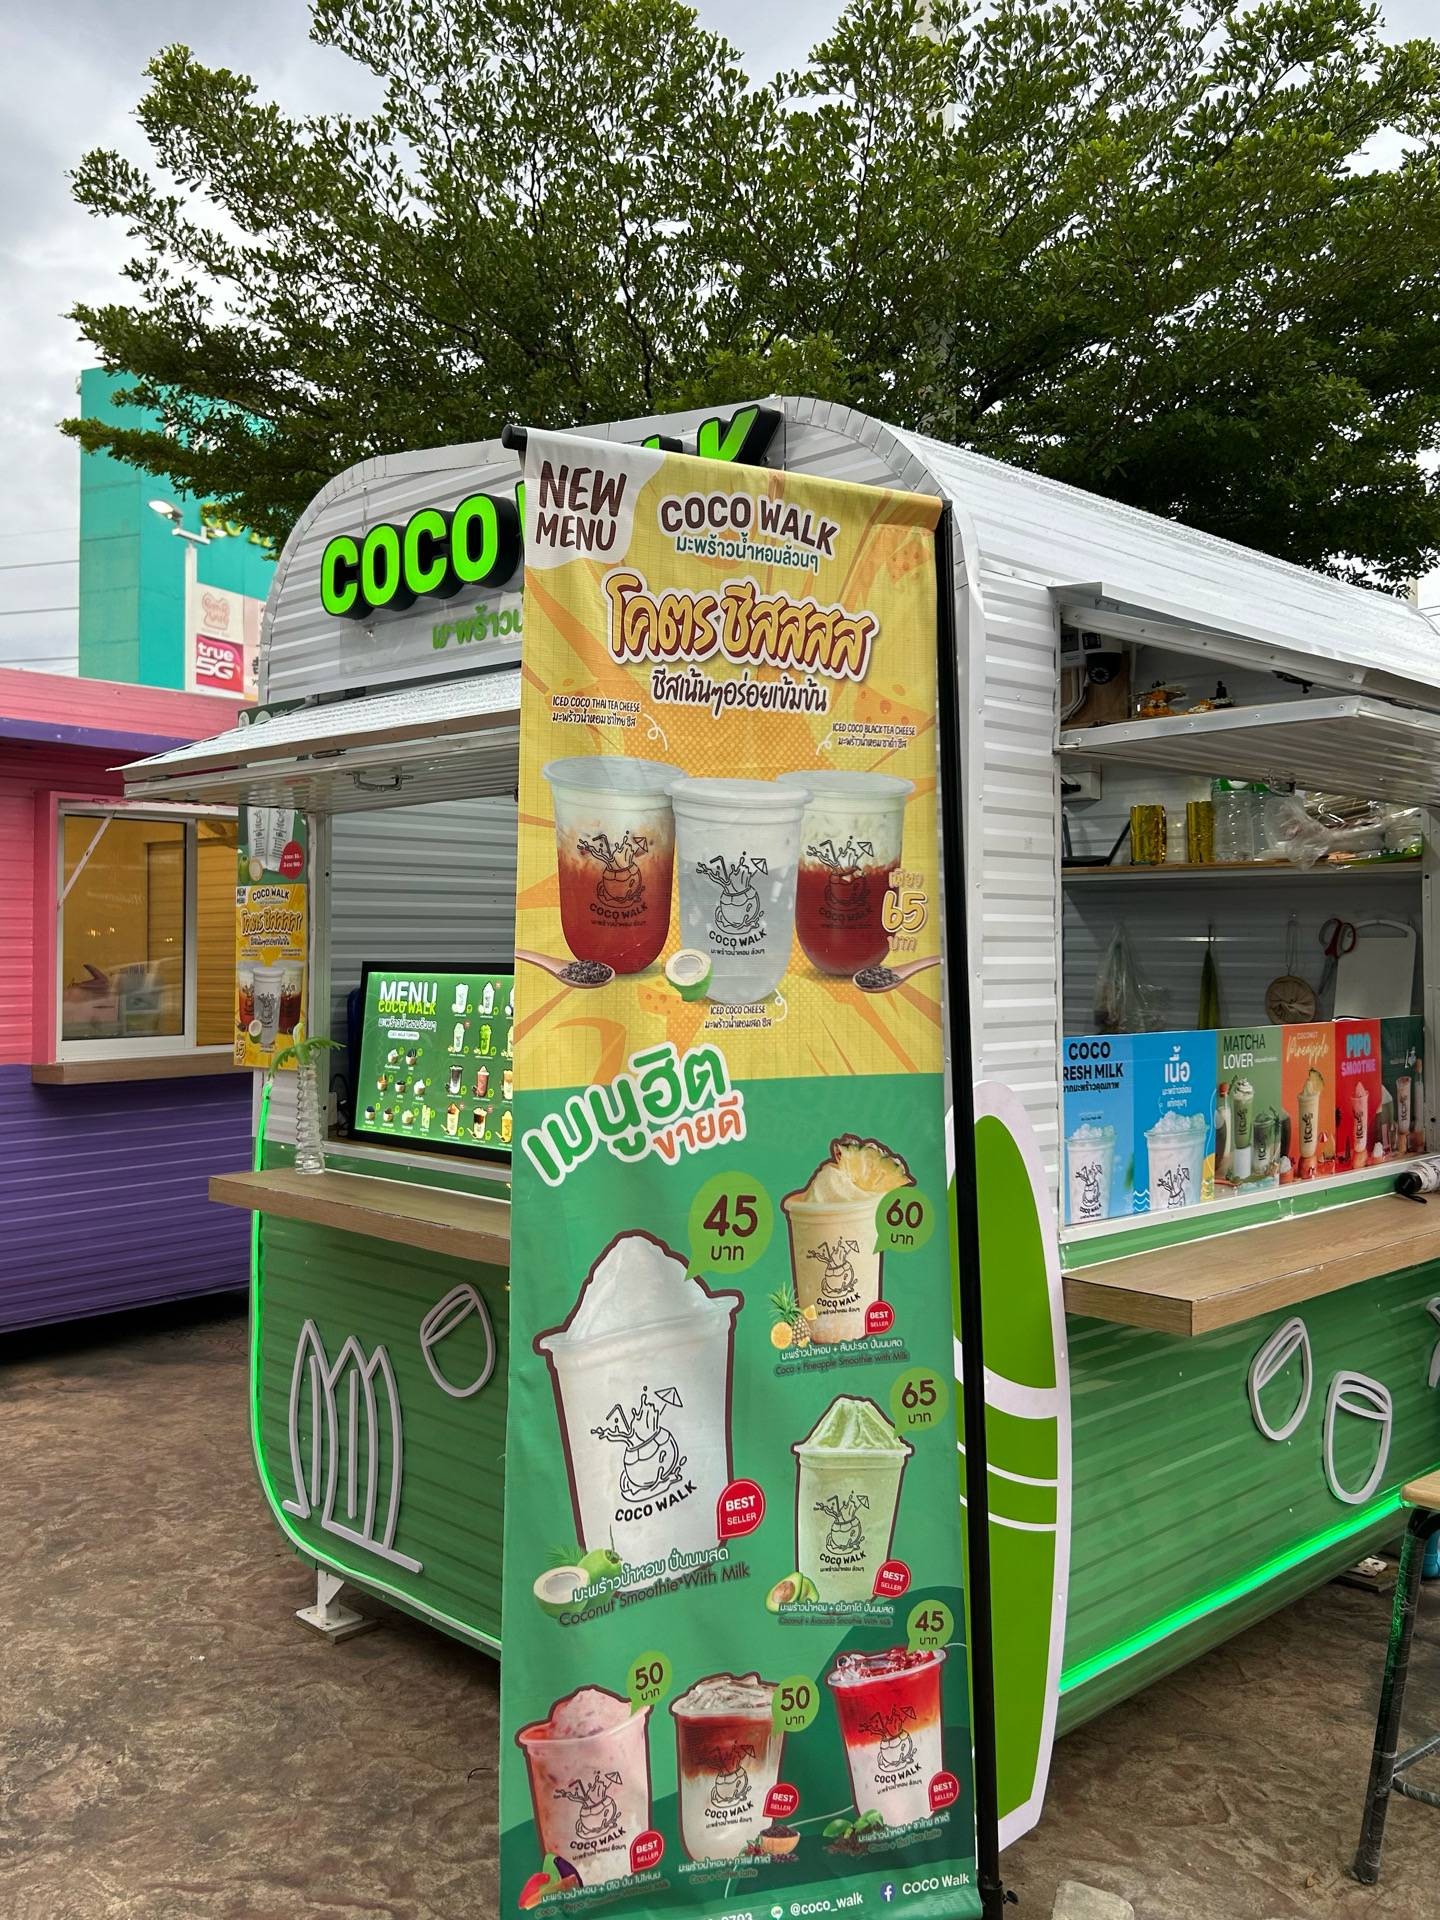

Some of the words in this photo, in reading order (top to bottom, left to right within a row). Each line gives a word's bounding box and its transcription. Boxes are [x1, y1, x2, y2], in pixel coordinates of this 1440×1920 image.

[538, 459, 627, 518] NEW
[535, 512, 617, 552] MENU
[661, 496, 751, 531] COCO
[760, 499, 839, 556] WALK
[321, 492, 500, 617] COCO
[676, 533, 820, 573] มะพร้าวน้ำหอมล้วนๆ
[605, 571, 718, 659] โคตร
[720, 582, 875, 677] ชีสสสส
[198, 642, 234, 661] true
[196, 656, 235, 680] 5G
[651, 667, 829, 717] ชีสเน้นๆอร่อยเข้มข้น
[553, 696, 569, 707] ICED
[570, 697, 591, 708] COCO
[592, 698, 607, 709] THAI
[608, 701, 619, 711] TEA
[619, 701, 640, 713] CHEESE
[552, 708, 606, 725] มะพร้าวน้ำหอม
[607, 712, 626, 727] ชาไทย
[626, 715, 636, 727] ชีส
[832, 722, 847, 732] ICED
[847, 723, 863, 733] COCO
[864, 725, 882, 734] BLACK
[882, 725, 895, 735] TEA
[895, 726, 916, 736] CHEESE
[252, 888, 270, 901] COCO
[271, 887, 289, 899] WALK
[589, 903, 620, 919] COCO
[622, 903, 648, 918] WALK
[882, 890, 927, 933] 65
[709, 930, 736, 946] COCO
[740, 928, 767, 946] WALK
[381, 981, 438, 1006] MENU
[378, 1000, 408, 1014] COCO
[408, 1001, 436, 1015] WALK
[710, 1005, 725, 1015] ICED
[725, 1005, 743, 1014] COCO
[744, 1005, 766, 1014] CHEESE
[1068, 1042, 1111, 1060] COCO
[1223, 1034, 1265, 1051] MATCHA
[1286, 1034, 1329, 1065] Pineapple
[1346, 1034, 1371, 1057] PIPO
[1164, 1045, 1190, 1083] เนื้อ
[1223, 1052, 1253, 1069] LOVER
[1341, 1059, 1376, 1076] SMOOTHIE
[1063, 1064, 1092, 1081] RESH
[1095, 1062, 1124, 1079] MILK
[527, 1046, 727, 1181] เมนูฮิต
[653, 1096, 741, 1160] ขายดี
[704, 1194, 759, 1238] 45
[886, 1198, 924, 1229] 60
[891, 1232, 914, 1246] บาท
[711, 1243, 745, 1261] บาท
[816, 1297, 837, 1309] COCO
[839, 1292, 861, 1306] WALK
[870, 1311, 889, 1319] BEST
[782, 1343, 831, 1360] มะพร้าวน้ำหอม
[902, 1379, 936, 1408] 65
[908, 1412, 931, 1424] บาท
[615, 1503, 653, 1522] COCO
[655, 1480, 697, 1512] WALK
[726, 1495, 755, 1512] BEST
[727, 1512, 756, 1526] SELLER
[819, 1553, 842, 1565] COCO
[843, 1551, 866, 1564] WALK
[572, 1560, 665, 1602] มะพร้าวน้ำหอม
[668, 1547, 729, 1571] ปั่นนมสด
[882, 1570, 905, 1582] BEST
[560, 1600, 615, 1627] Coconut
[619, 1579, 679, 1607] Smoothie
[683, 1568, 716, 1590] With
[722, 1561, 750, 1582] Milk
[880, 1581, 902, 1591] SELLER
[780, 1600, 827, 1612] มะพร้าวน้ำหอม
[915, 1610, 944, 1632] 45
[920, 1637, 938, 1645] บาท
[635, 1662, 664, 1690] 50
[641, 1688, 660, 1701] บาท
[780, 1686, 811, 1711] 50
[785, 1715, 804, 1726] บาท
[874, 1774, 897, 1784] COCO
[898, 1762, 922, 1780] WALK
[933, 1781, 953, 1793] BEST
[772, 1792, 794, 1802] BEST
[934, 1792, 954, 1802] SELLER
[704, 1808, 728, 1819] COCO
[729, 1801, 754, 1817] WALK
[770, 1803, 791, 1811] SELLER
[569, 1840, 598, 1851] COCO
[599, 1826, 627, 1846] WALK
[636, 1840, 658, 1854] BEST
[637, 1851, 659, 1863] SELLER
[902, 1878, 939, 1895] COCO
[941, 1873, 970, 1887] Walk
[790, 1892, 863, 1916] @coco_walk
